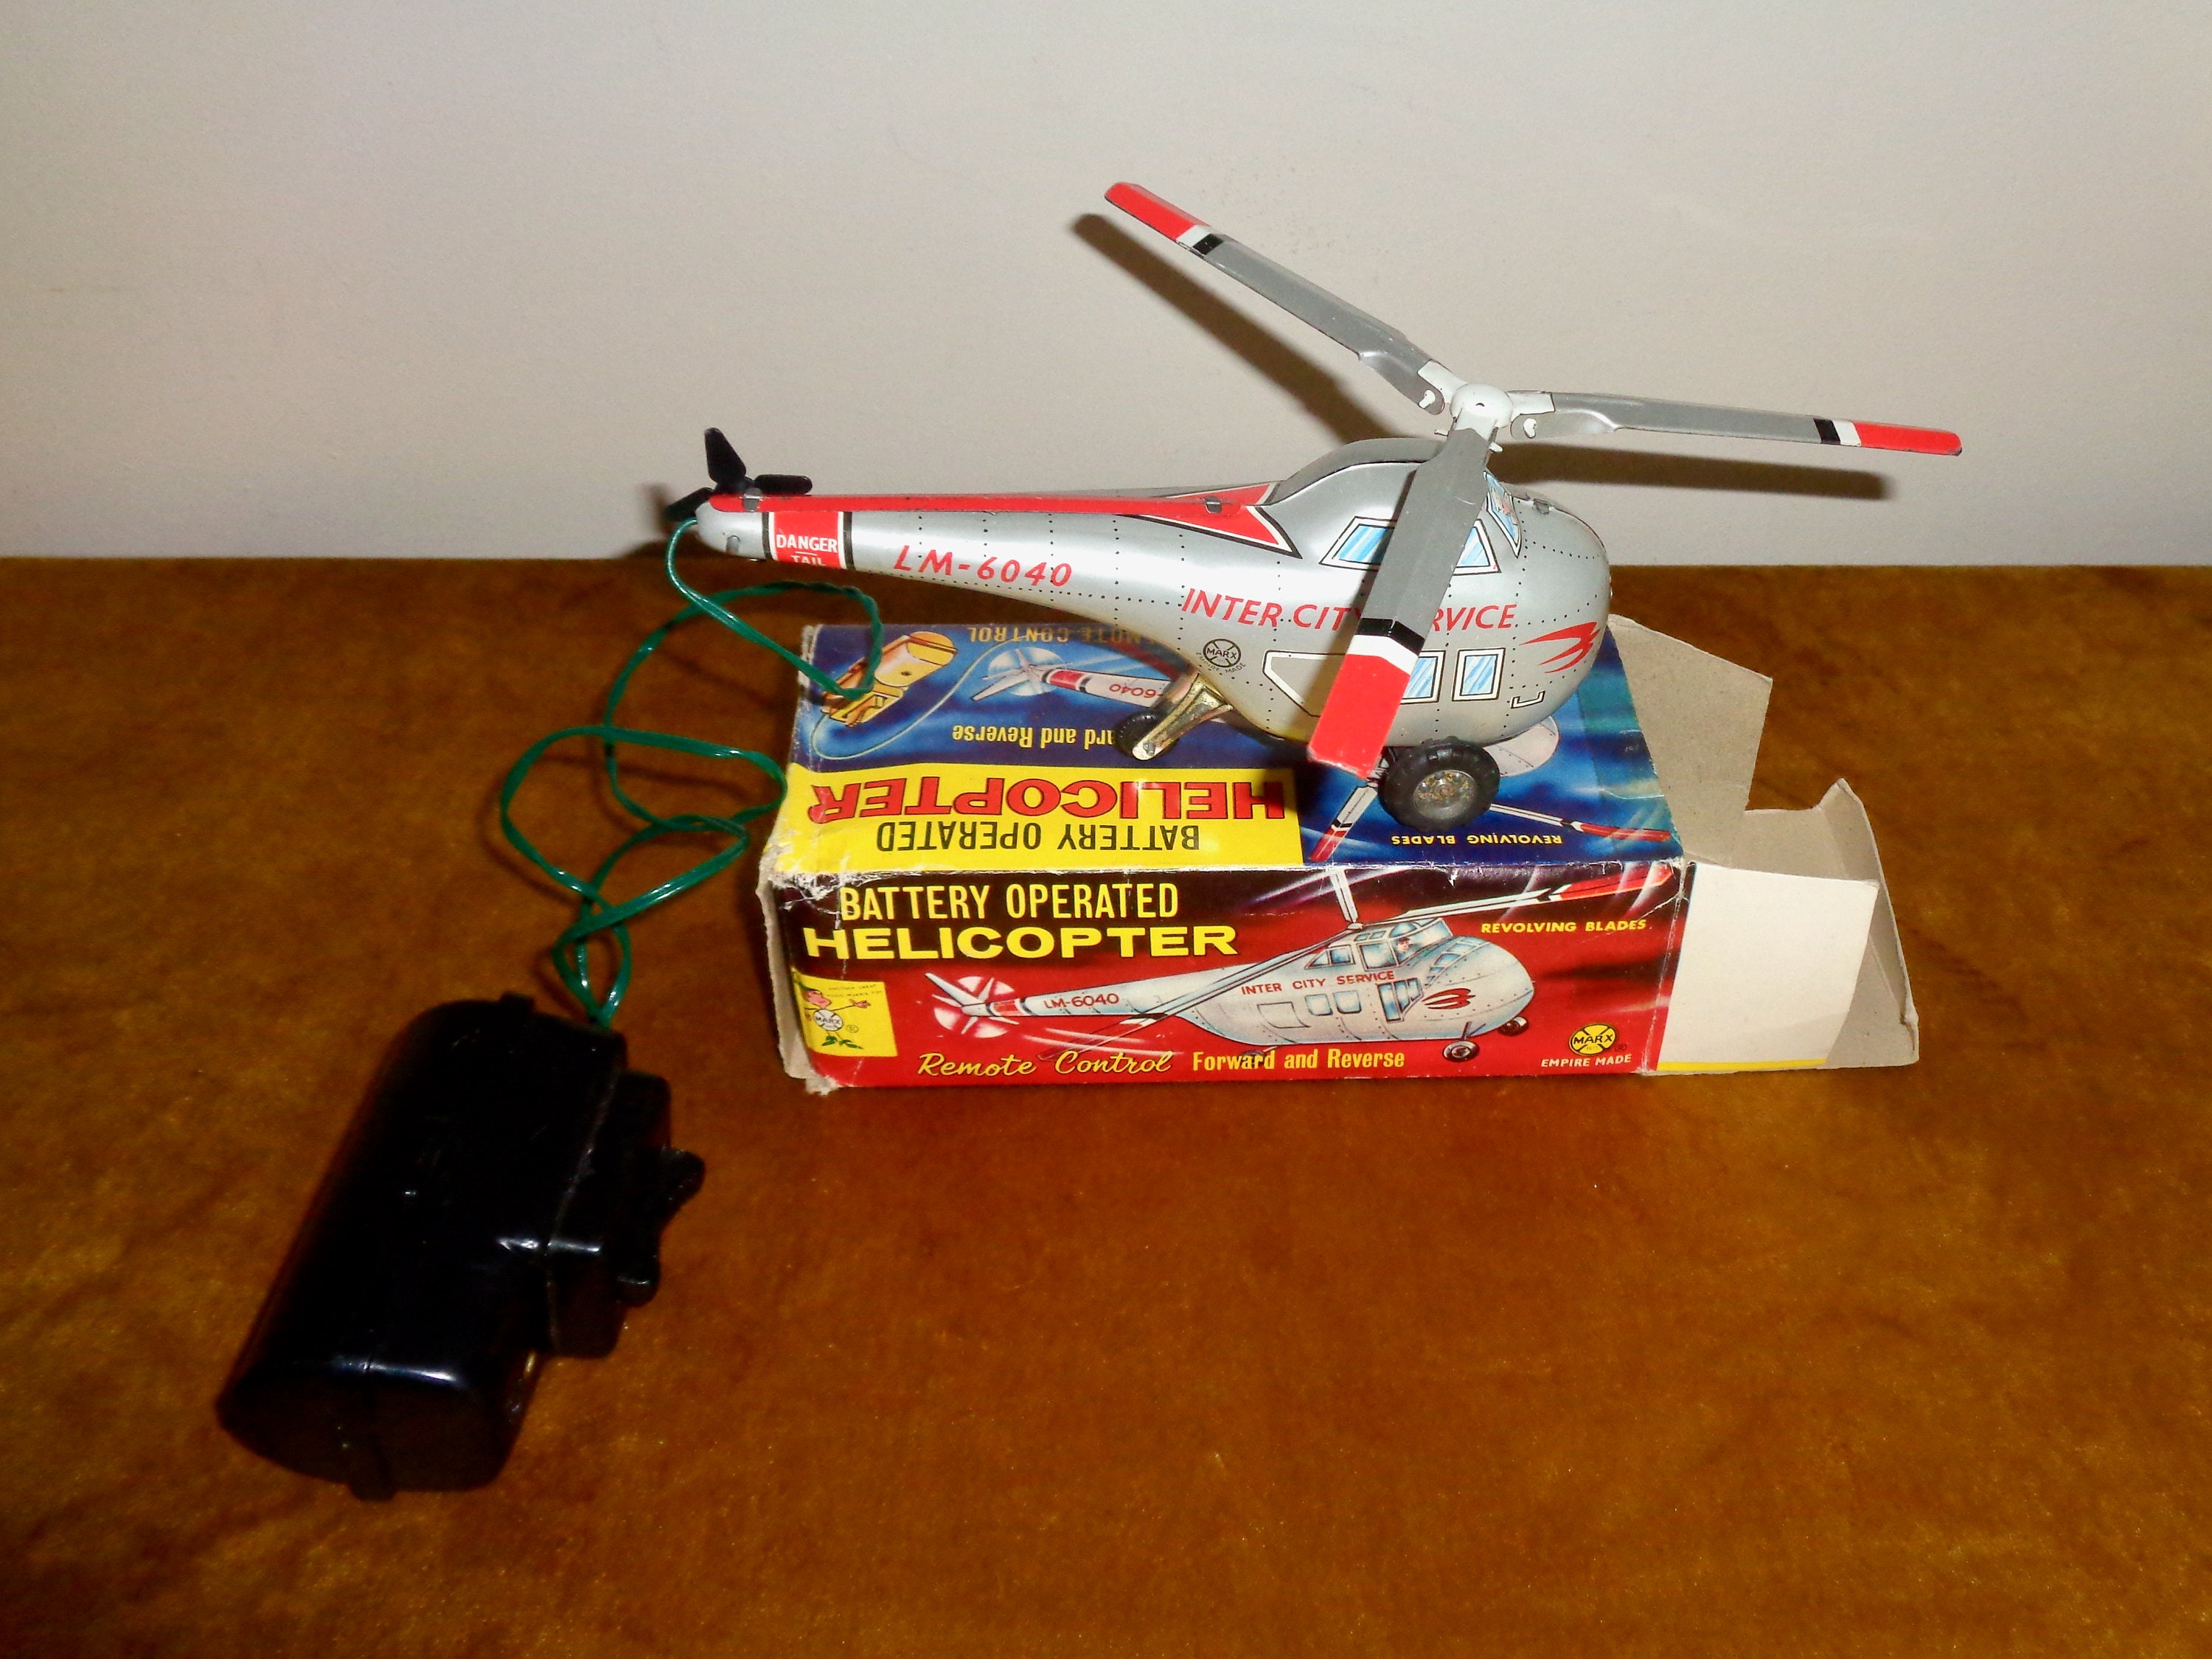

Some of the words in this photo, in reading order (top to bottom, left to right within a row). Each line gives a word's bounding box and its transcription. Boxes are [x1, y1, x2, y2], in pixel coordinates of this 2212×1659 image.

[776, 534, 838, 553] DANGER
[790, 554, 827, 566] TAIL
[894, 545, 1073, 587] LM-6040
[1182, 588, 1282, 627] INTER
[1432, 603, 1518, 631] RVICE
[968, 626, 1069, 643] CONTROL
[1206, 647, 1237, 660] MARX
[951, 725, 1033, 748] Reverse
[1040, 728, 1077, 749] and
[807, 776, 1286, 824] HELICOPTER
[877, 821, 1042, 852] OPERATED
[1057, 824, 1200, 851] BATTERY
[1391, 835, 1456, 846] BLADES
[1467, 834, 1563, 844] REVOLVING
[838, 885, 990, 922] BATTERY
[1006, 883, 1179, 919] OPERATED
[1481, 921, 1577, 934] REVOLVING
[1585, 919, 1647, 932] BLADES
[802, 925, 1238, 960] HELICOPTER
[1241, 982, 1283, 995] INTER
[1293, 977, 1326, 990] CITY
[1336, 970, 1396, 986] SERVICE
[1043, 992, 1120, 1009] LM-6040
[1573, 1034, 1613, 1045] MARX
[918, 1052, 1037, 1077] Remote
[1054, 1050, 1175, 1074] Control
[1192, 1050, 1276, 1072] Forward
[1284, 1050, 1319, 1071] and
[1327, 1048, 1405, 1070] Reverse
[1541, 1057, 1590, 1068] EMPIRE
[1595, 1054, 1632, 1066] MADE
